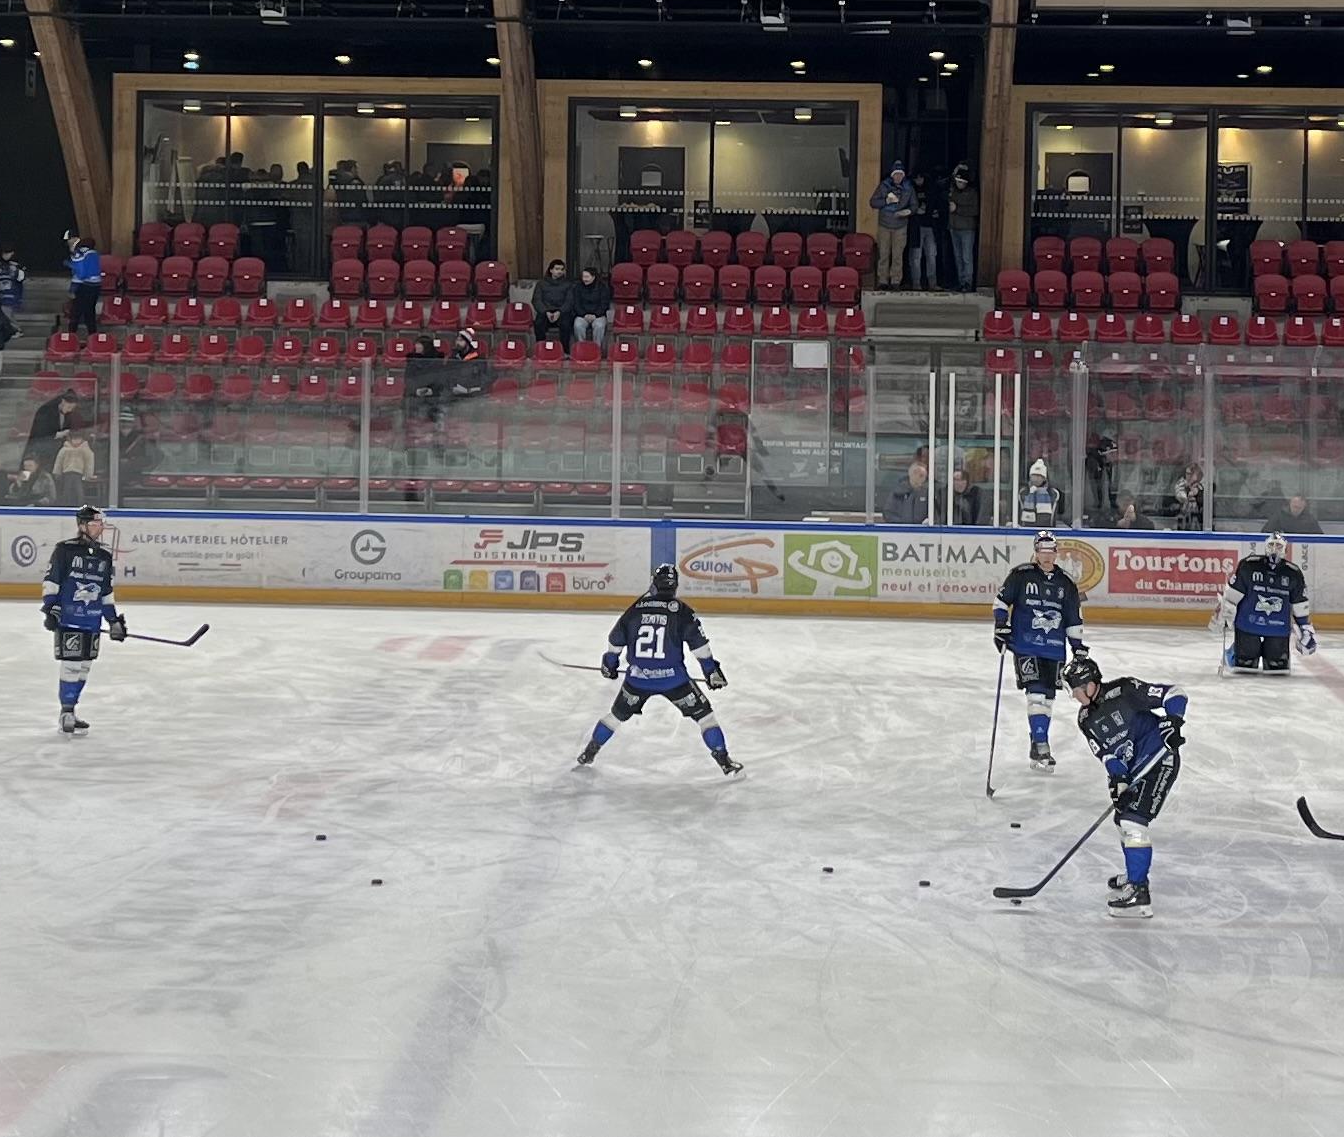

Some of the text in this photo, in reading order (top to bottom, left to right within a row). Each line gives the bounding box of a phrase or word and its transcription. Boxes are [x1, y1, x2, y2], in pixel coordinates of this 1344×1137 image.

[132, 535, 288, 545] ALPES MATERIEL HÔTELIER
[507, 530, 585, 552] JPS
[474, 551, 585, 563] DISTRIBUTION
[1113, 550, 1234, 574] Tourtons
[690, 561, 733, 573] GUION
[334, 568, 402, 582] Groupama
[882, 581, 912, 592] neuf
[918, 582, 931, 593] et
[1135, 579, 1153, 590] du
[636, 625, 666, 659] 21
